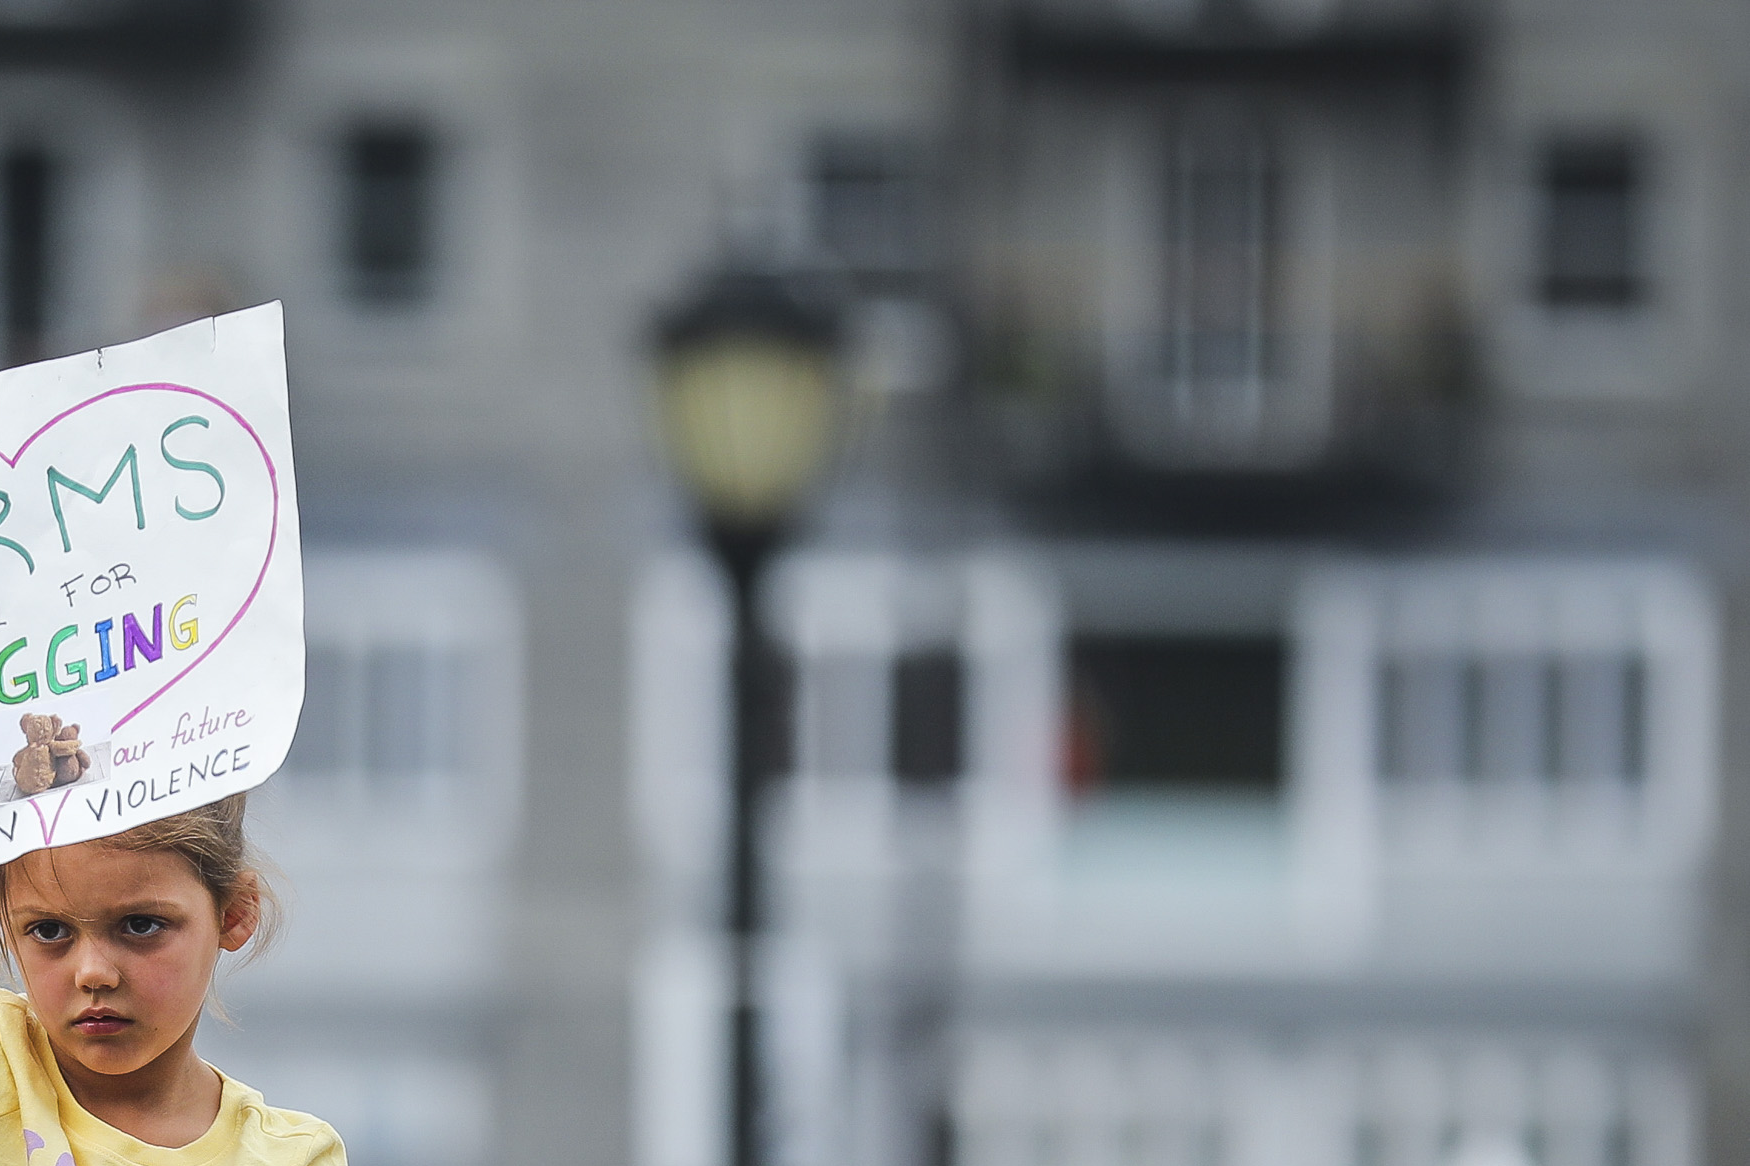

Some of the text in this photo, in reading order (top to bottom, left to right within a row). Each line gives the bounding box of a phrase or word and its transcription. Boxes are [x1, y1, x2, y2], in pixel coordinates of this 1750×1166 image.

[61, 563, 136, 607] FOR
[113, 735, 153, 767] our
[171, 706, 252, 750] future
[86, 745, 251, 821] VIOLENCE
